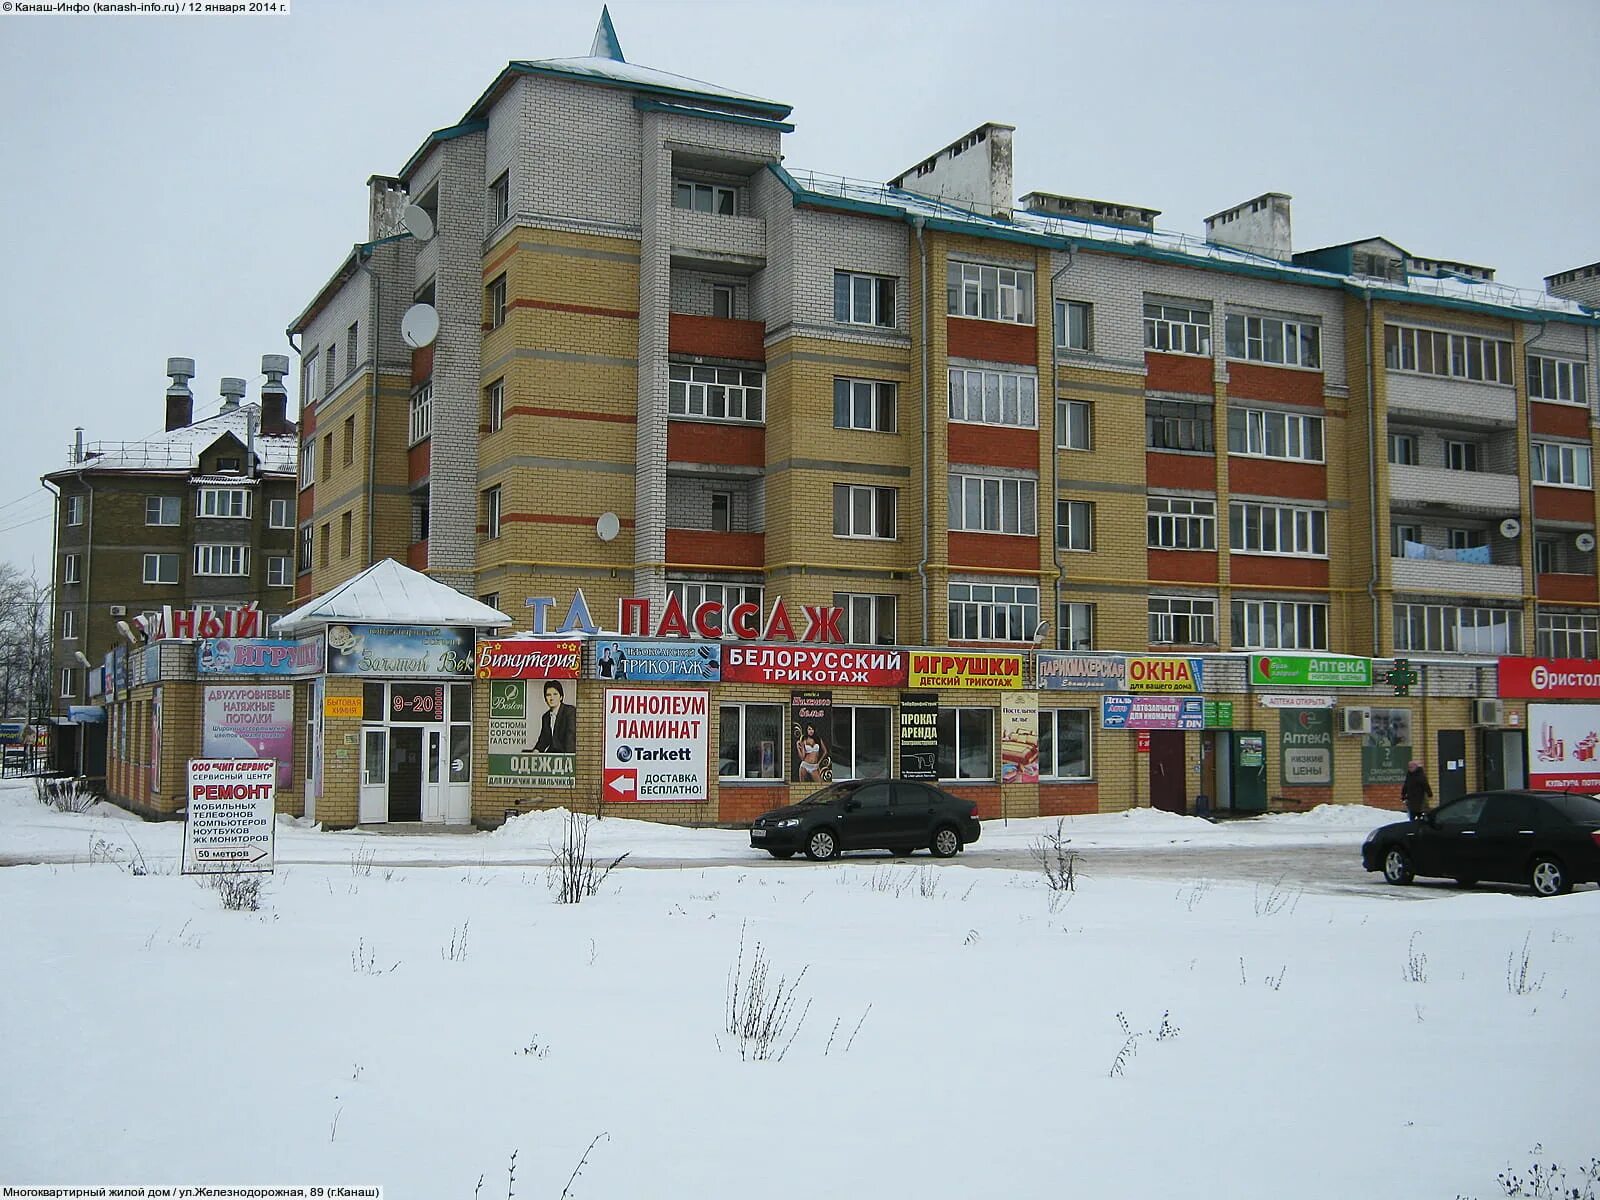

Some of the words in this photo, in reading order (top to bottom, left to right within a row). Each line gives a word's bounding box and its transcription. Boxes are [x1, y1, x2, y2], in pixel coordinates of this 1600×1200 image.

[617, 589, 846, 644] ПАССАЖ
[479, 646, 577, 678] Бижутерия
[729, 648, 902, 670] БЕЛОРУССКИЙ
[621, 659, 704, 675] ТРИКОТАЖ
[913, 655, 1020, 676] ИГРУШКИ
[1039, 658, 1126, 678] ПАРИКМАХЕРСКАЯ
[1129, 660, 1190, 681] ОКНА
[763, 668, 869, 683] ТРИКОТАЖ
[919, 676, 960, 687] ДЕТСКИЙ
[965, 677, 1013, 687] ТРИКОТАЖ
[208, 689, 291, 701] ДВУХУРОВНЕВЫЕ
[223, 701, 276, 712] НАТЯЖНЫЕ
[326, 698, 362, 706] БЫТОВАЯ
[394, 695, 434, 713] 9-20
[492, 696, 523, 710] Boston
[610, 695, 706, 715] ЛИНОЛЕУМ
[1296, 698, 1326, 706] ОТКРЫТА
[331, 706, 357, 714] ХИМИЯ
[1132, 704, 1180, 713] АВТОЗАПЧАСТИ
[225, 713, 273, 724] ПОТОЛКИ
[901, 713, 938, 725] ПРОКАТ
[1177, 719, 1184, 728] 2
[1186, 720, 1202, 728] DIN
[490, 721, 527, 729] КОСТЮМЫ
[615, 719, 701, 739] ЛАМИНАТ
[901, 726, 938, 740] АРЕНДА
[490, 737, 527, 745] ГАЛСТУКИ
[634, 747, 692, 761] Tarkett
[191, 763, 211, 772] ООО
[212, 763, 235, 772] "ЧИП
[235, 762, 274, 772] СЕРВИС"
[510, 756, 574, 774] ОДЕЖДА
[1292, 766, 1323, 776] ЦЕНЫ
[193, 773, 243, 781] СЕРВИСНЫЙ
[246, 773, 272, 781] ЦЕНТР
[645, 774, 698, 785] ДОСТАВКА
[193, 784, 273, 801] РЕМОНТ
[640, 785, 702, 795] БЕСПЛАТНО!
[193, 803, 257, 811] МОБИЛЬНЫХ
[193, 811, 254, 819] ТЕЛЕФОНОВ
[193, 819, 267, 827] КОМПЬЮТЕРОВ
[193, 828, 249, 836] НОУТБУКОВ
[209, 836, 269, 844] МОНИТОРОВ
[198, 850, 210, 858] 50
